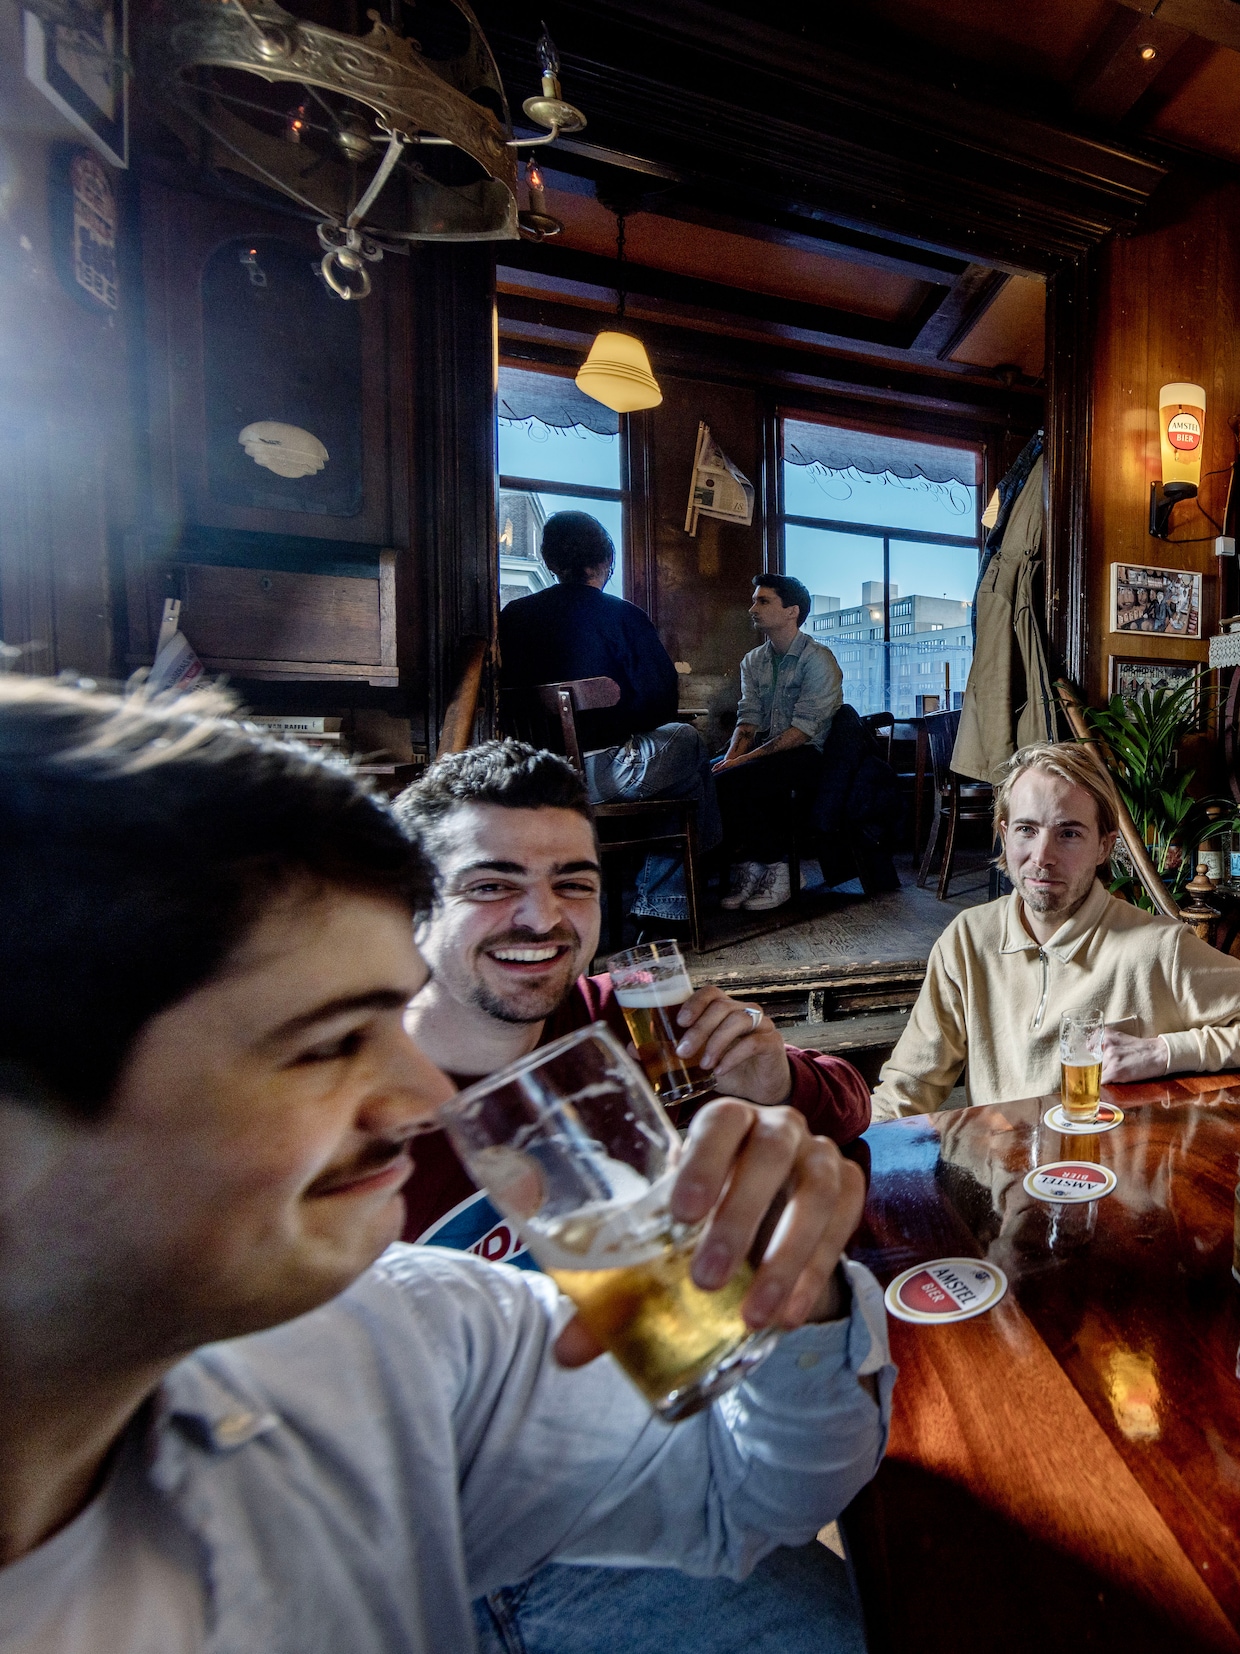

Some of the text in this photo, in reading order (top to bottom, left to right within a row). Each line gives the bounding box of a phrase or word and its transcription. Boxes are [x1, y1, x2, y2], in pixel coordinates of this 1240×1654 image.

[1172, 422, 1198, 432] AMSTEL
[1176, 433, 1194, 443] BIER
[1062, 1171, 1089, 1181] BIER
[1041, 1176, 1098, 1190] AMSTEL
[932, 1268, 977, 1305] AMSTEL
[921, 1282, 945, 1304] BIER
